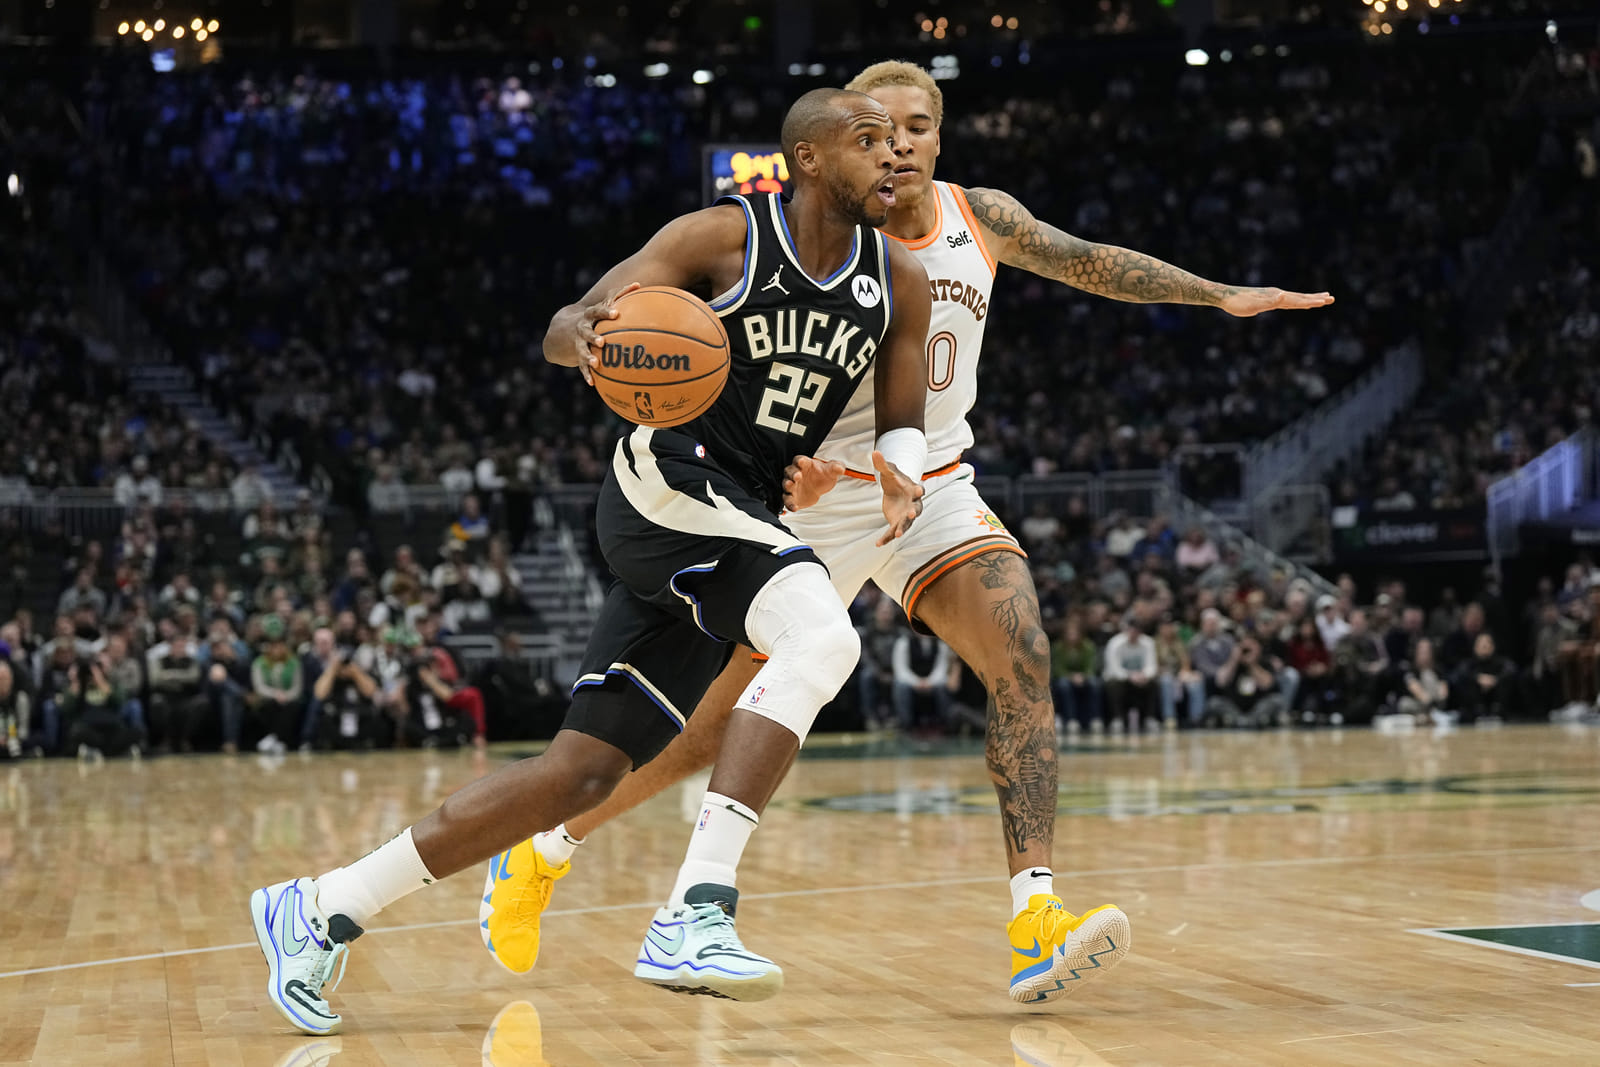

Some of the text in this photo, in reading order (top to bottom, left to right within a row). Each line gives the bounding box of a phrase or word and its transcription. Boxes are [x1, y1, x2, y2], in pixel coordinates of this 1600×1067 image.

[946, 230, 973, 249] Self.
[602, 343, 691, 372] Wilson
[743, 308, 877, 380] BUCKS
[755, 361, 832, 437] 22
